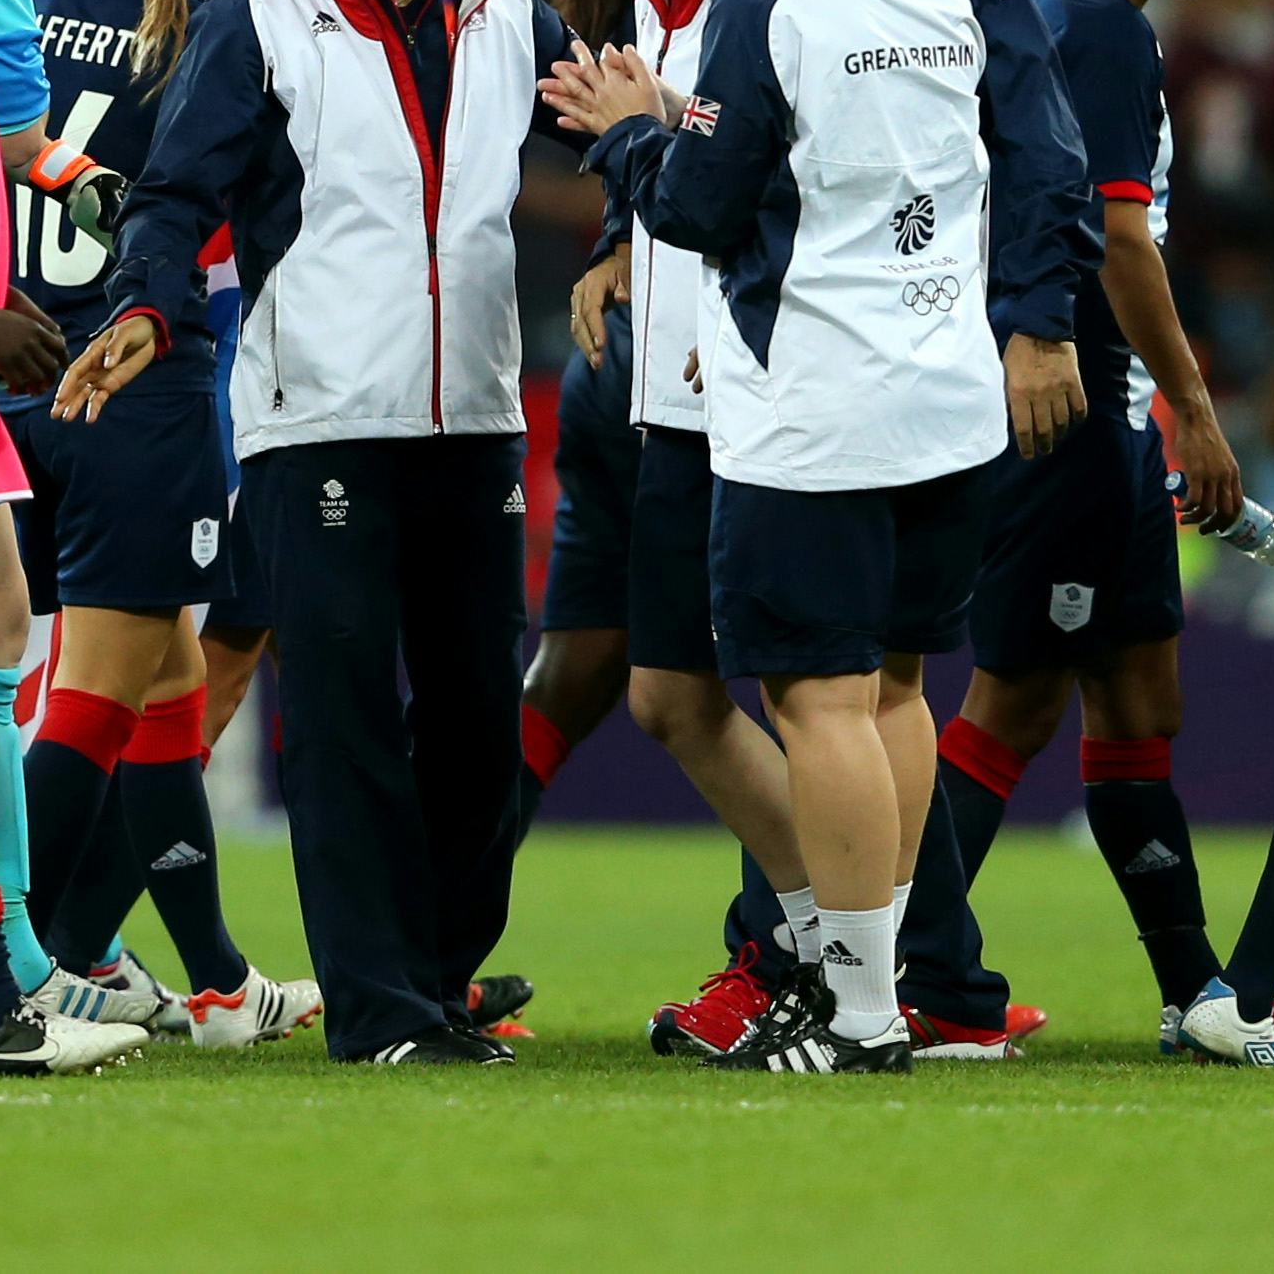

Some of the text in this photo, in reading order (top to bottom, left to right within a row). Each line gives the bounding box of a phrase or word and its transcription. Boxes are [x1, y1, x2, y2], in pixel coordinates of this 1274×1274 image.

[36, 14, 140, 70] FFERT
[844, 46, 909, 75] GREAT
[150, 852, 207, 871] adidas
